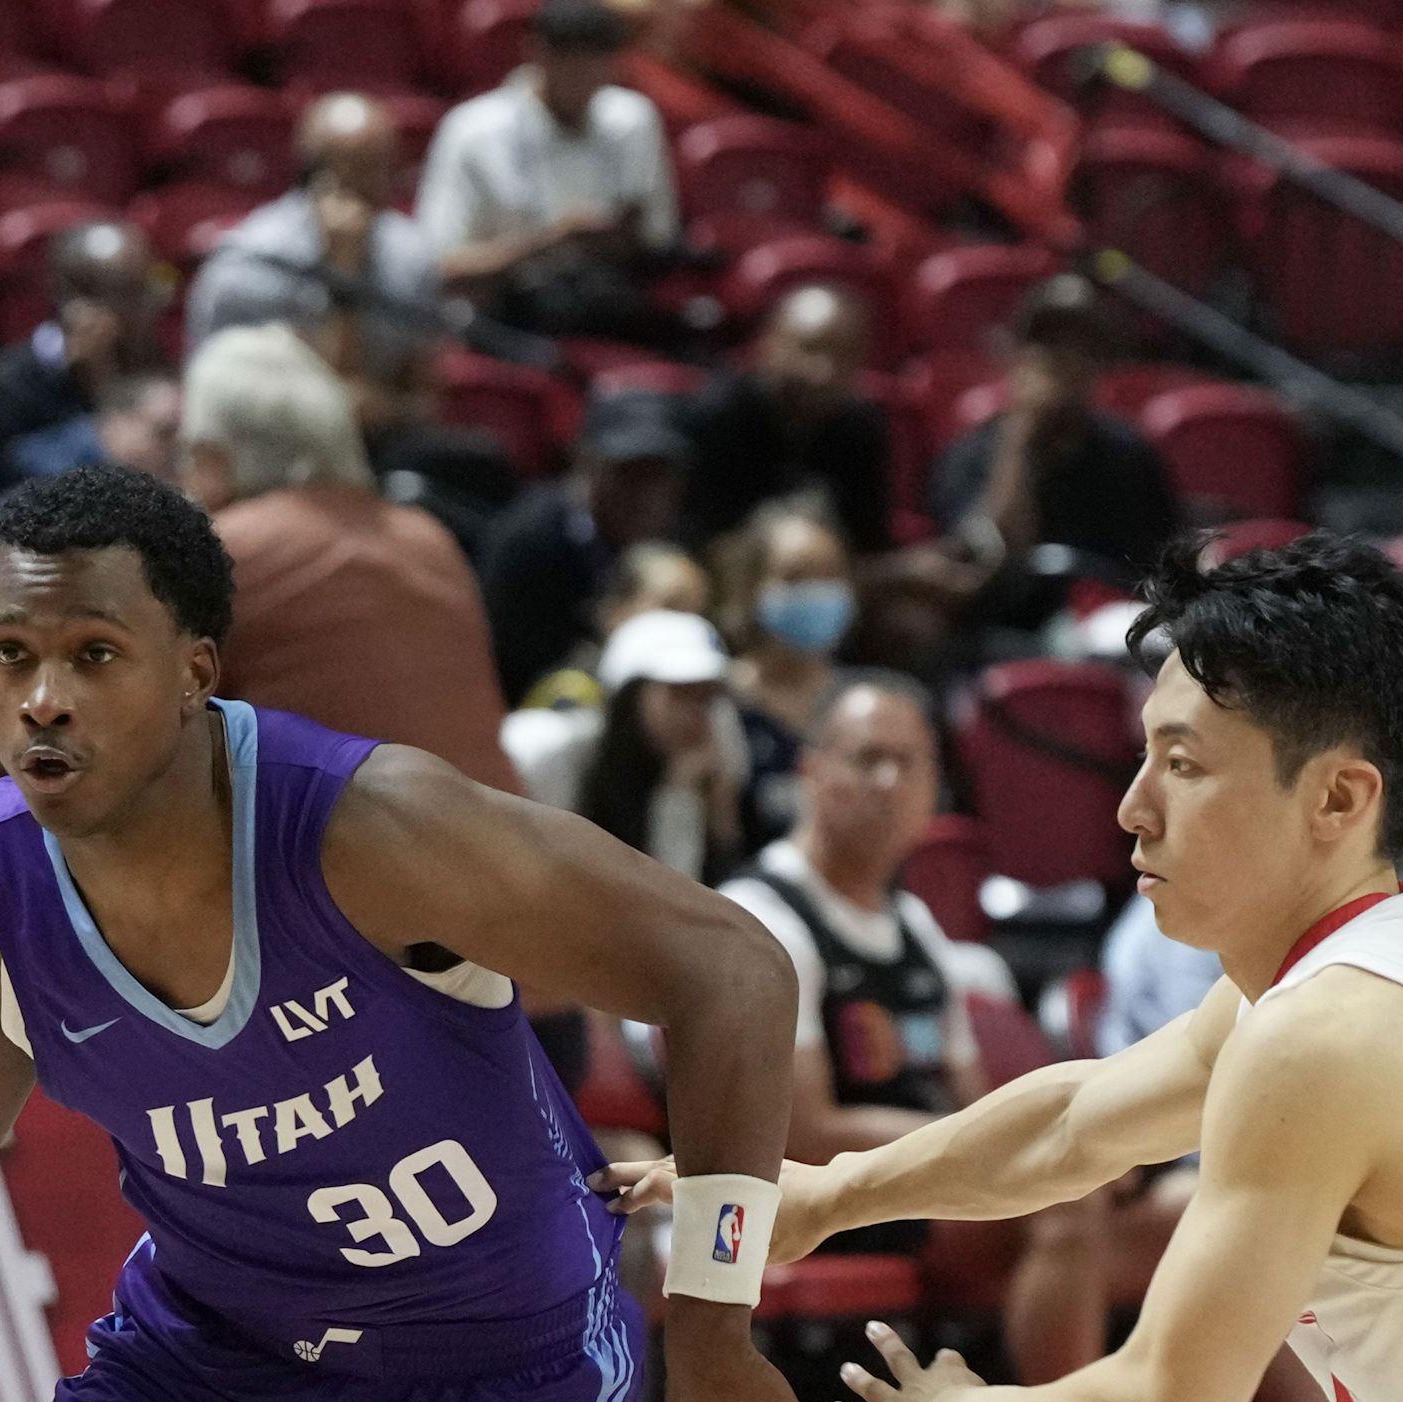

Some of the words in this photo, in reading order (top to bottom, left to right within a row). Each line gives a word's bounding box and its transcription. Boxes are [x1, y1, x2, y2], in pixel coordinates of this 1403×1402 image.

[270, 976, 356, 1042] LVT
[146, 1054, 384, 1188] UTAH
[307, 1139, 497, 1267] 30
